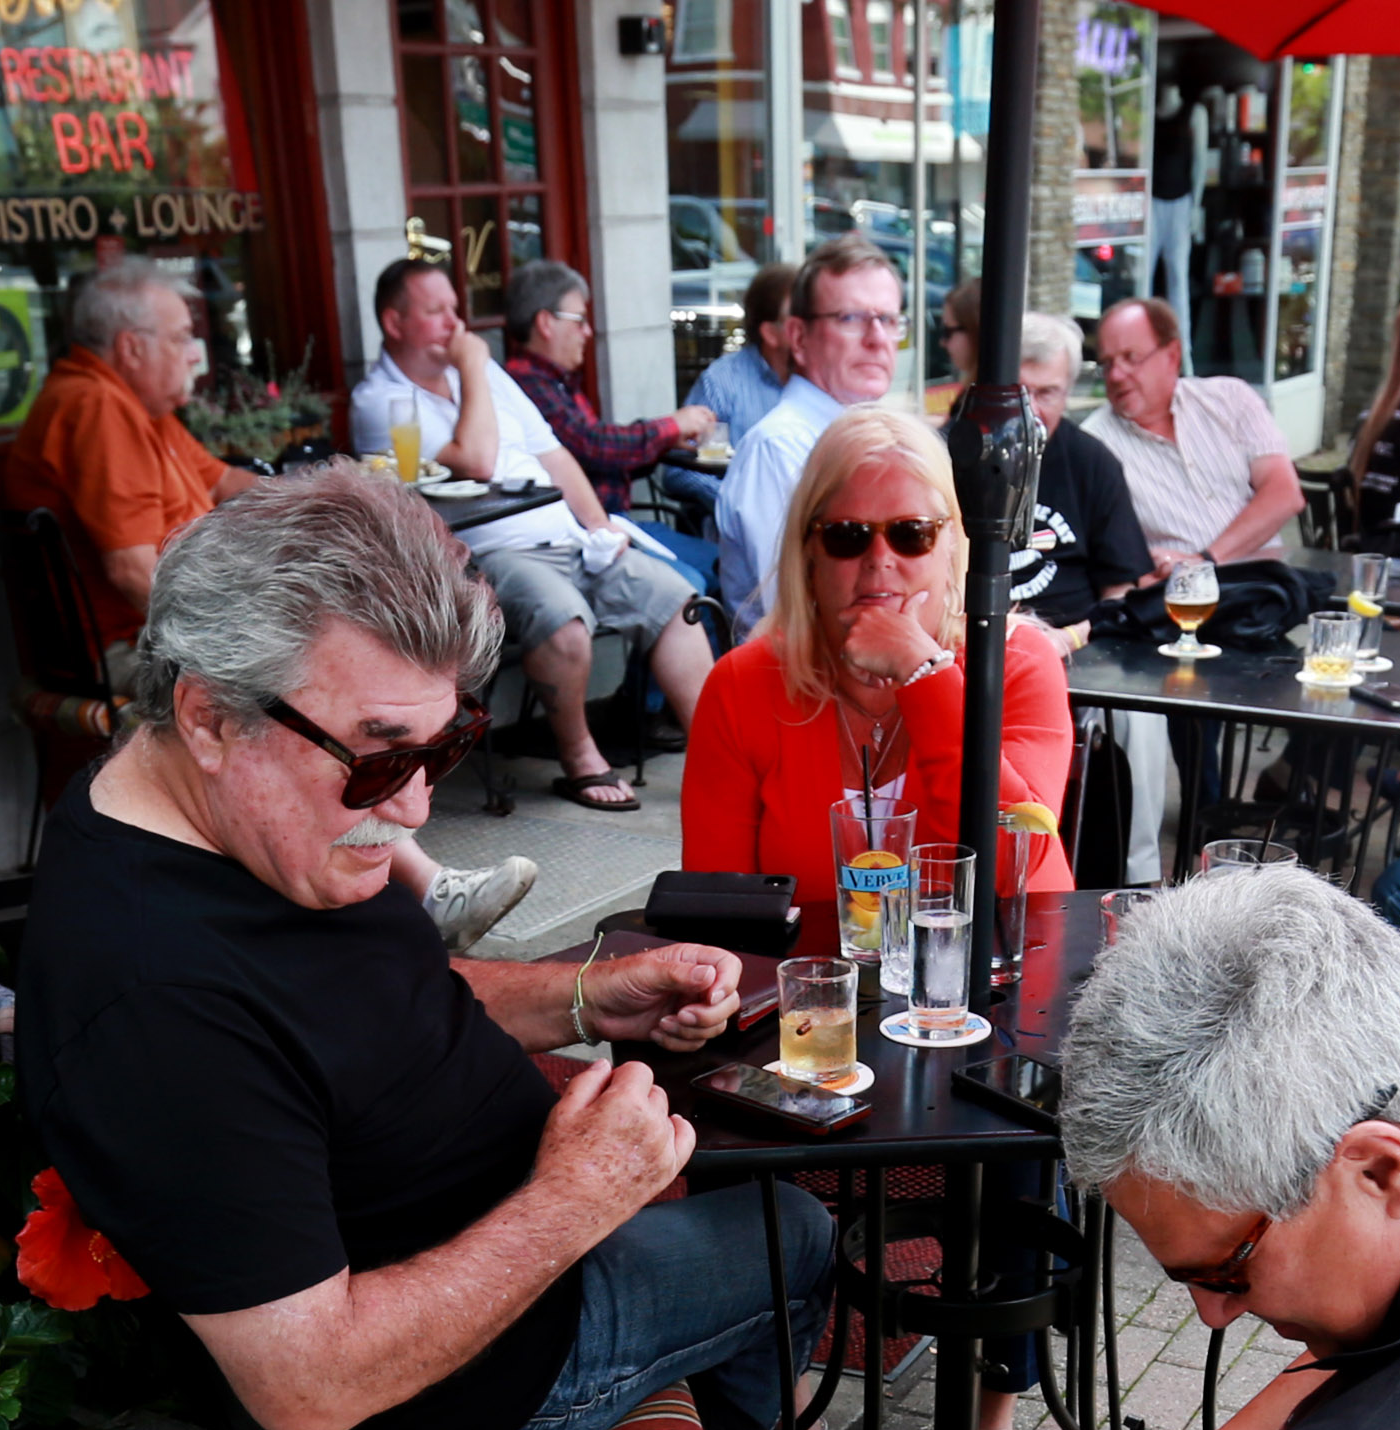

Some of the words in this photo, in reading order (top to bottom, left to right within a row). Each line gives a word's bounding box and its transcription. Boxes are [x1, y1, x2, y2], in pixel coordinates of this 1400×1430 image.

[0, 45, 197, 104] RESTAURANT
[51, 111, 155, 174] BAR
[133, 192, 265, 237] LOUNGE
